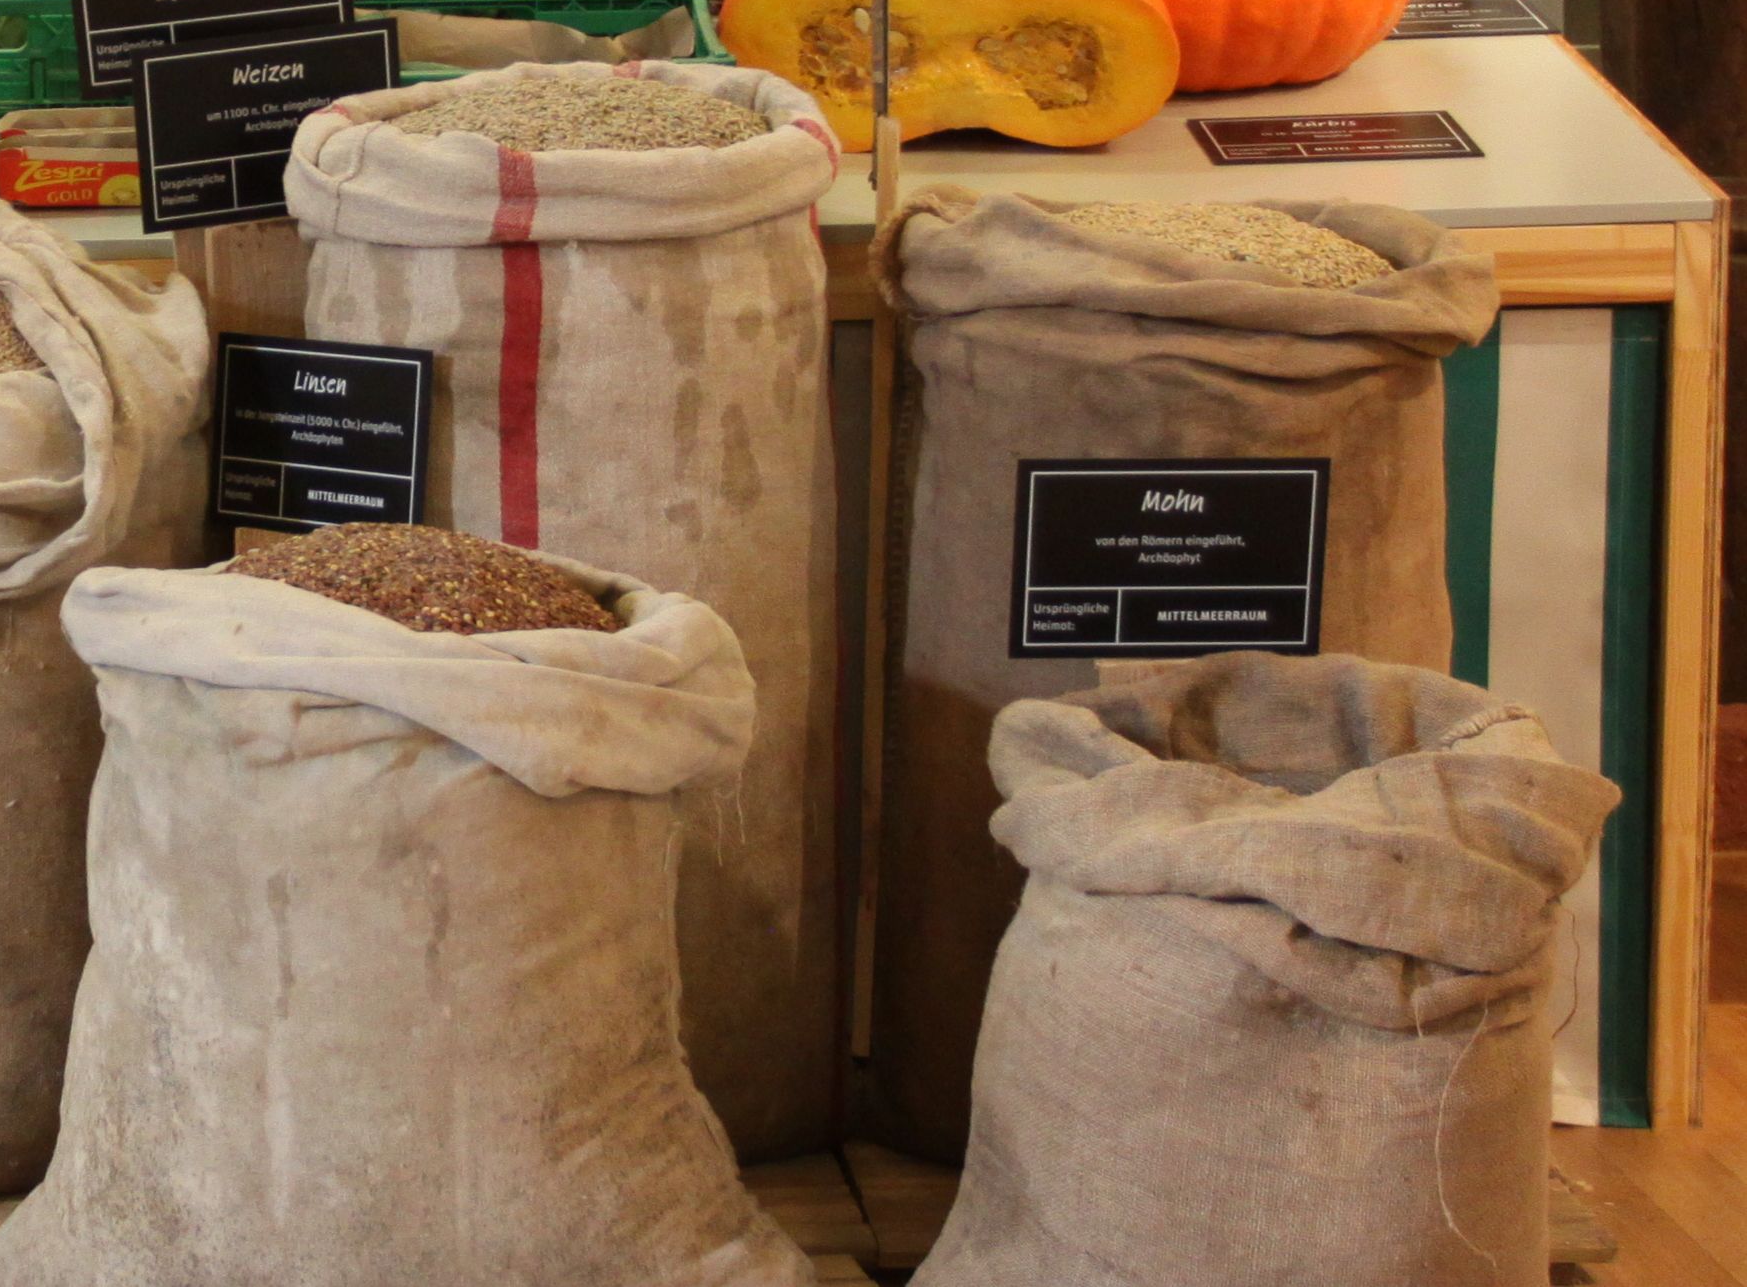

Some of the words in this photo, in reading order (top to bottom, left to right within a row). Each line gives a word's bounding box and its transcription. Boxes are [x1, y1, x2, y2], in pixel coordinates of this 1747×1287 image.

[232, 63, 304, 85] Weizen
[207, 112, 222, 121] um
[262, 104, 281, 114] Chr.
[13, 158, 105, 192] Zespri
[160, 173, 227, 190] Ursprüngliche
[47, 189, 93, 203] GOLD
[293, 370, 347, 395] Linsen
[341, 418, 360, 431] Chr.)
[361, 421, 404, 435] eingeführt,
[307, 489, 384, 508] MITTELMEERRAUM
[1141, 489, 1204, 512] Mohn
[1095, 536, 1115, 546] von
[1118, 534, 1138, 546] den
[1141, 534, 1182, 546] Römern
[1185, 534, 1245, 548] eingeführt,
[1033, 602, 1109, 616] Ursprüngliche
[1157, 610, 1267, 621] MITTELMEERRAUM
[1032, 620, 1076, 631] Heimat:
